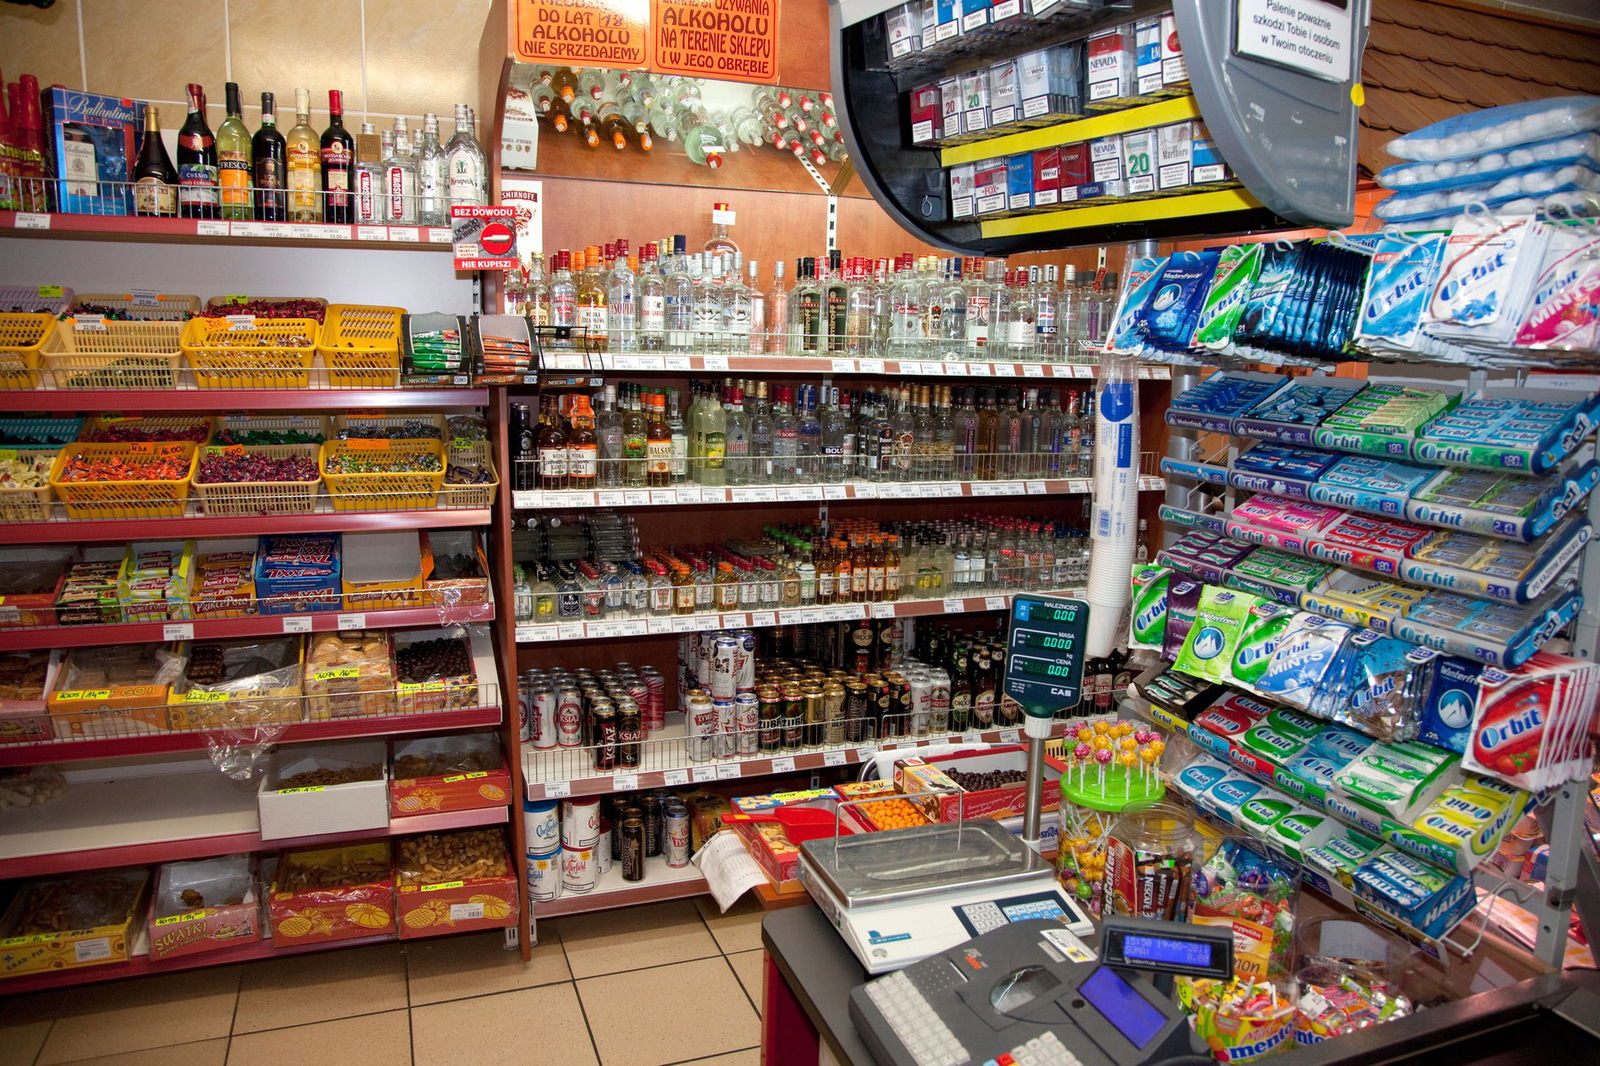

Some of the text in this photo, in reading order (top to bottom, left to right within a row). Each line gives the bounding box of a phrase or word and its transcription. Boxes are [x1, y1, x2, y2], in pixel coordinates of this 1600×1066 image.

[539, 9, 560, 22] DO
[565, 10, 593, 25] LAT
[663, 7, 768, 36] ALKOHOLU
[1266, 0, 1332, 30] Palenie poważnie
[533, 24, 630, 45] ALKOHOLU
[1253, 14, 1285, 31] szkodzi
[1287, 22, 1308, 38] Tobie
[1313, 33, 1340, 50] osobom
[524, 41, 640, 60] NIE SPRZEDAJEMY
[661, 27, 770, 58] NA TERENIE SKLEPU
[1261, 34, 1333, 64] w Twoim otoczeniu
[662, 51, 769, 75] I W JEGO OBRĘBIE
[1090, 56, 1118, 69] NEVADA
[968, 94, 980, 108] 20
[220, 161, 248, 170] FRESCO
[1128, 153, 1149, 174] 20
[984, 186, 997, 195] FOX
[454, 208, 512, 216] BEZ DOWODU
[1440, 253, 1508, 302] Orbit
[1367, 270, 1425, 319] Orbit
[1535, 270, 1578, 305] Orbit
[1199, 288, 1240, 329] Orbit
[1530, 275, 1600, 328] MINTS
[1320, 432, 1362, 449] Orbit
[1420, 444, 1471, 463] Orbit
[1232, 474, 1268, 490] Orbit
[1315, 488, 1356, 506] Orbit
[1415, 506, 1463, 525] Orbit
[1231, 527, 1264, 543] Orbit
[1312, 544, 1352, 562] Orbit
[1407, 566, 1457, 587] Orbit
[196, 596, 248, 613] PRINCE POLO
[1137, 596, 1168, 630] Orbit
[1306, 599, 1344, 618] Orbit
[1200, 609, 1240, 626] Winterfresh
[1401, 626, 1446, 649] Orbit
[1276, 640, 1309, 661] Orbit
[1268, 652, 1325, 678] MINTS
[1051, 687, 1072, 697] CAS
[1353, 676, 1395, 709] Orbit
[1235, 697, 1270, 714] Orbit
[1152, 709, 1172, 725] Orbit
[1279, 710, 1314, 730] Orbit
[1190, 730, 1213, 746] Orbit
[1480, 708, 1543, 749] Orbit
[1256, 728, 1292, 749] Orbit
[1231, 750, 1256, 768] Orbit
[1187, 769, 1209, 783] Orbit
[1277, 773, 1304, 792] Orbit
[1219, 784, 1244, 799] Orbit
[1249, 802, 1275, 819] Orbit
[1328, 798, 1358, 818] Orbit
[1445, 797, 1492, 820] Orbit
[1283, 818, 1311, 836] Orbit
[1427, 816, 1473, 839] Orbit
[1311, 848, 1340, 866] HALLS
[1330, 839, 1360, 857] HALLS
[1373, 861, 1416, 889] HALLS
[1359, 872, 1401, 899] HALLS
[1424, 879, 1471, 926] HALLS
